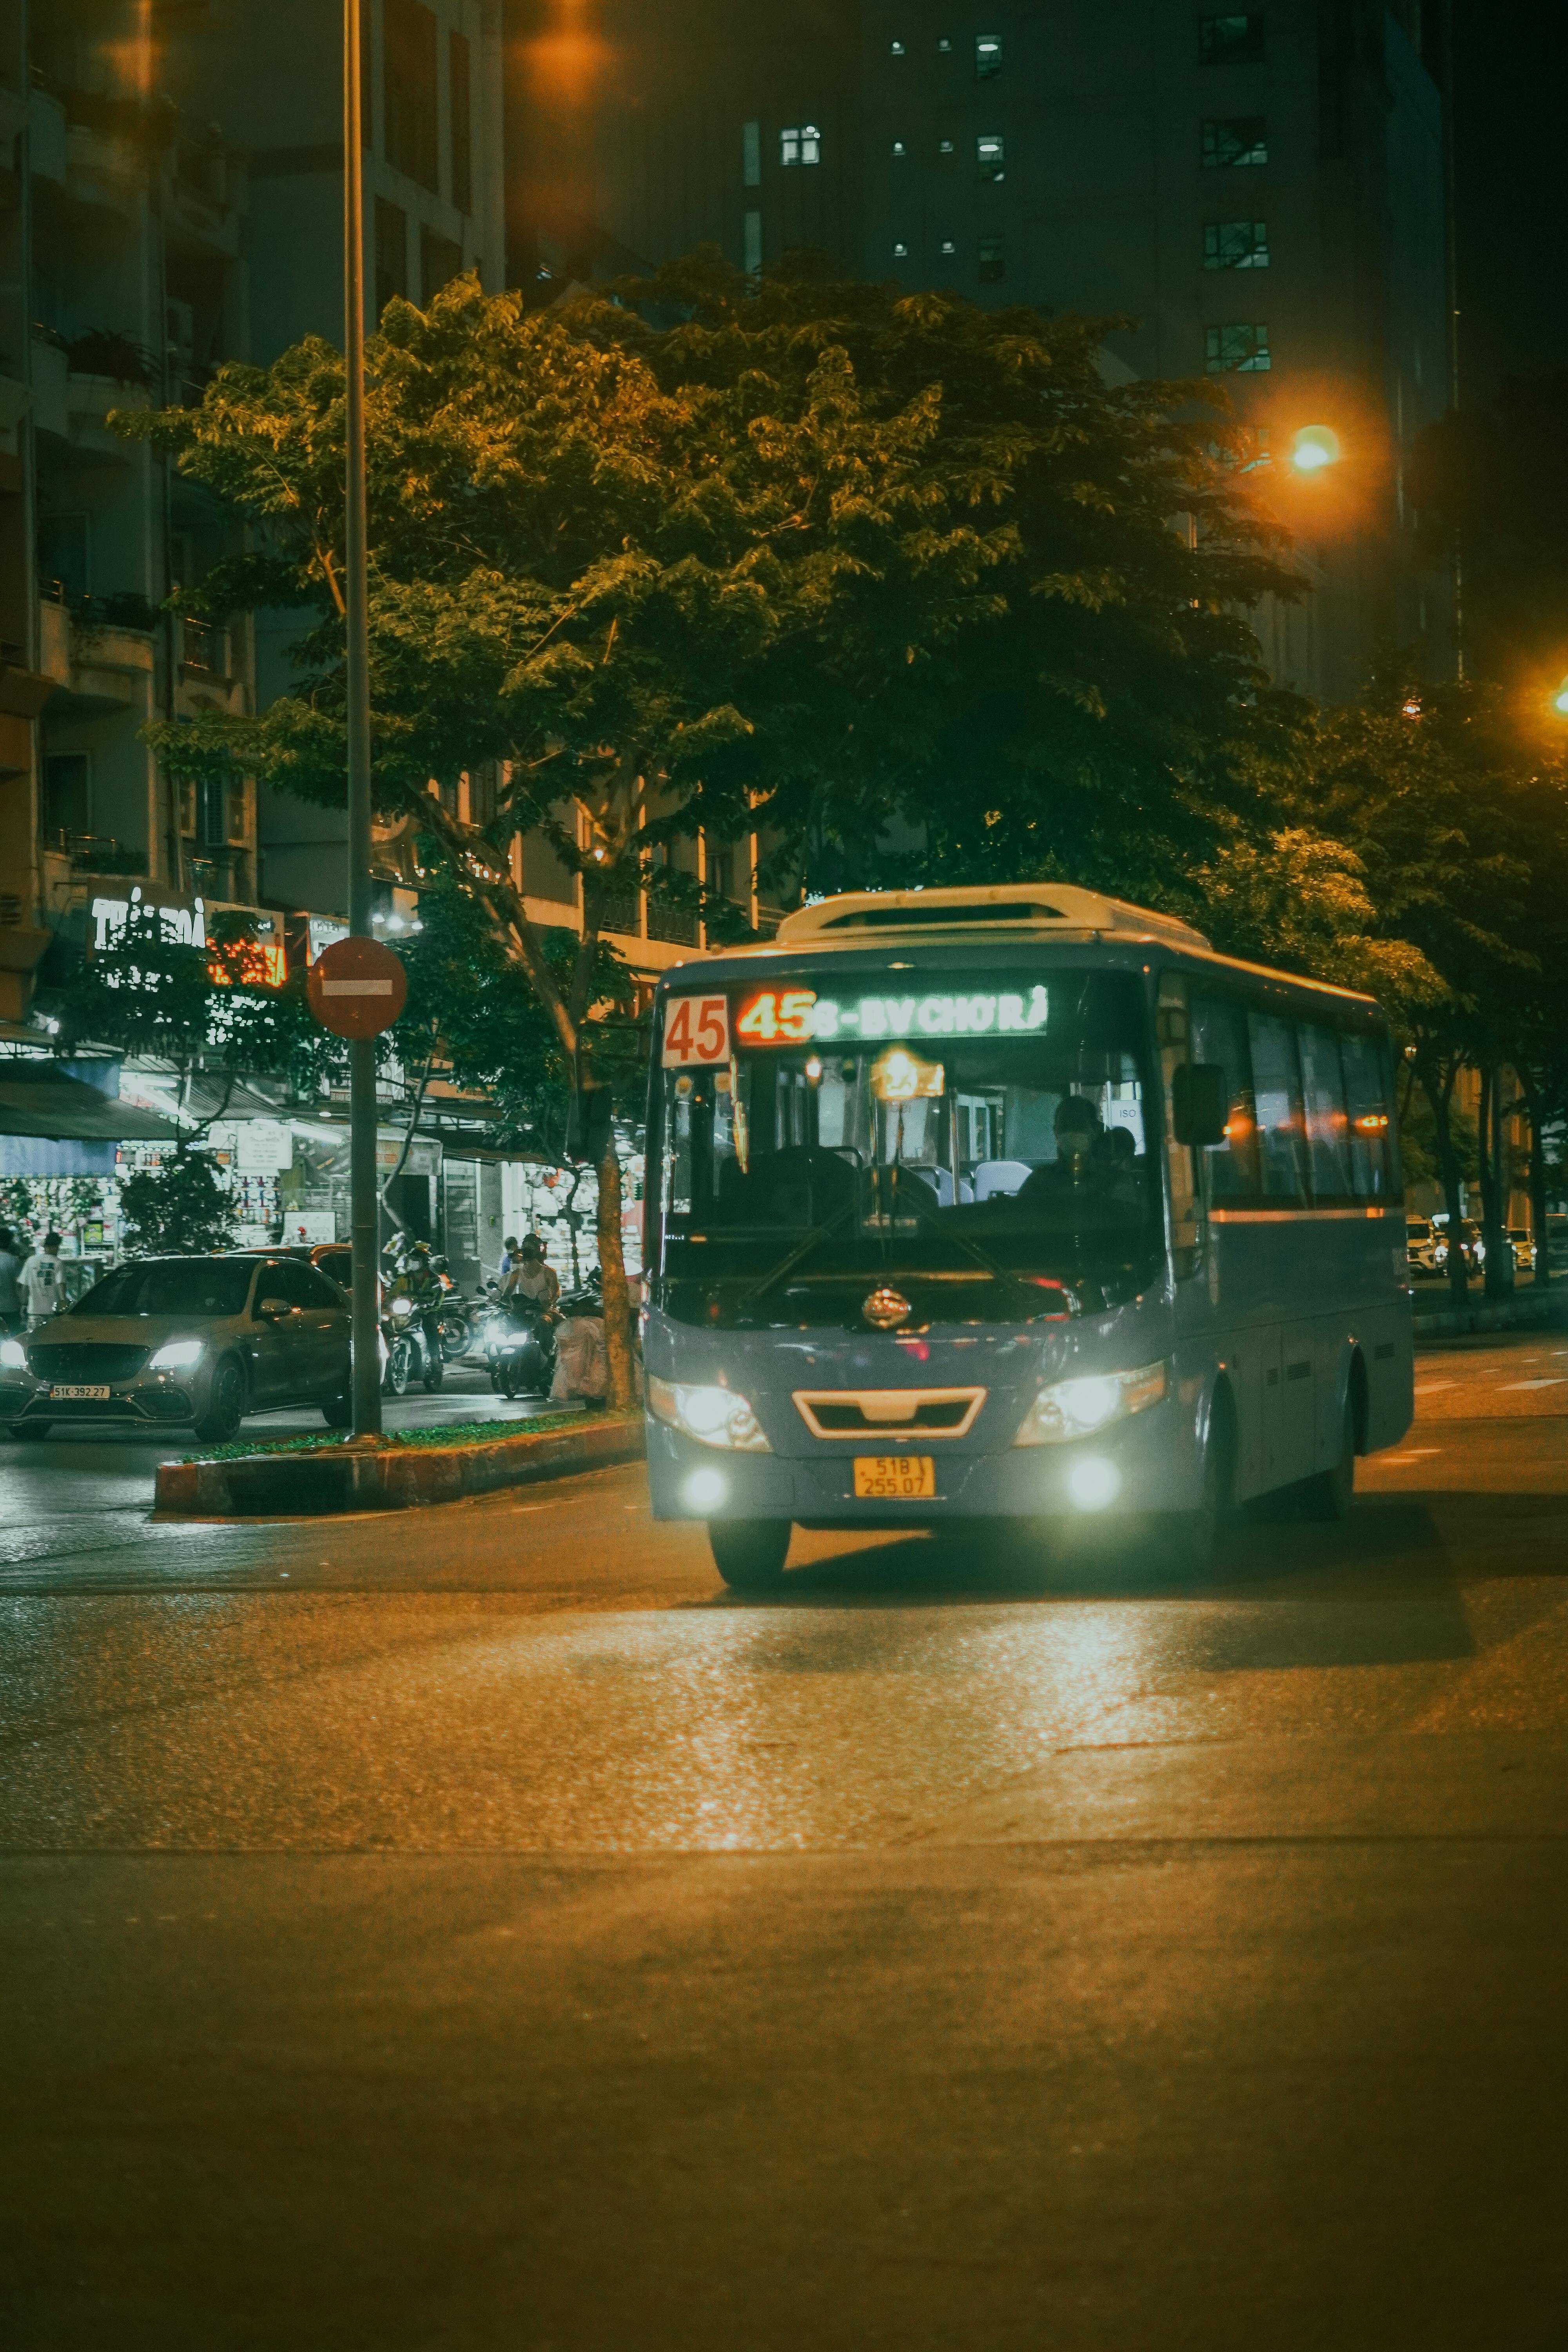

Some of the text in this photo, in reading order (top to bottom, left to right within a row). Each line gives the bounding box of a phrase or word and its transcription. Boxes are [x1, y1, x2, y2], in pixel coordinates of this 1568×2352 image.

[665, 1000, 725, 1061] 45
[739, 993, 815, 1039] 45
[860, 999, 916, 1035] BV
[1120, 1109, 1136, 1118] ISO
[877, 1459, 910, 1475] 51B
